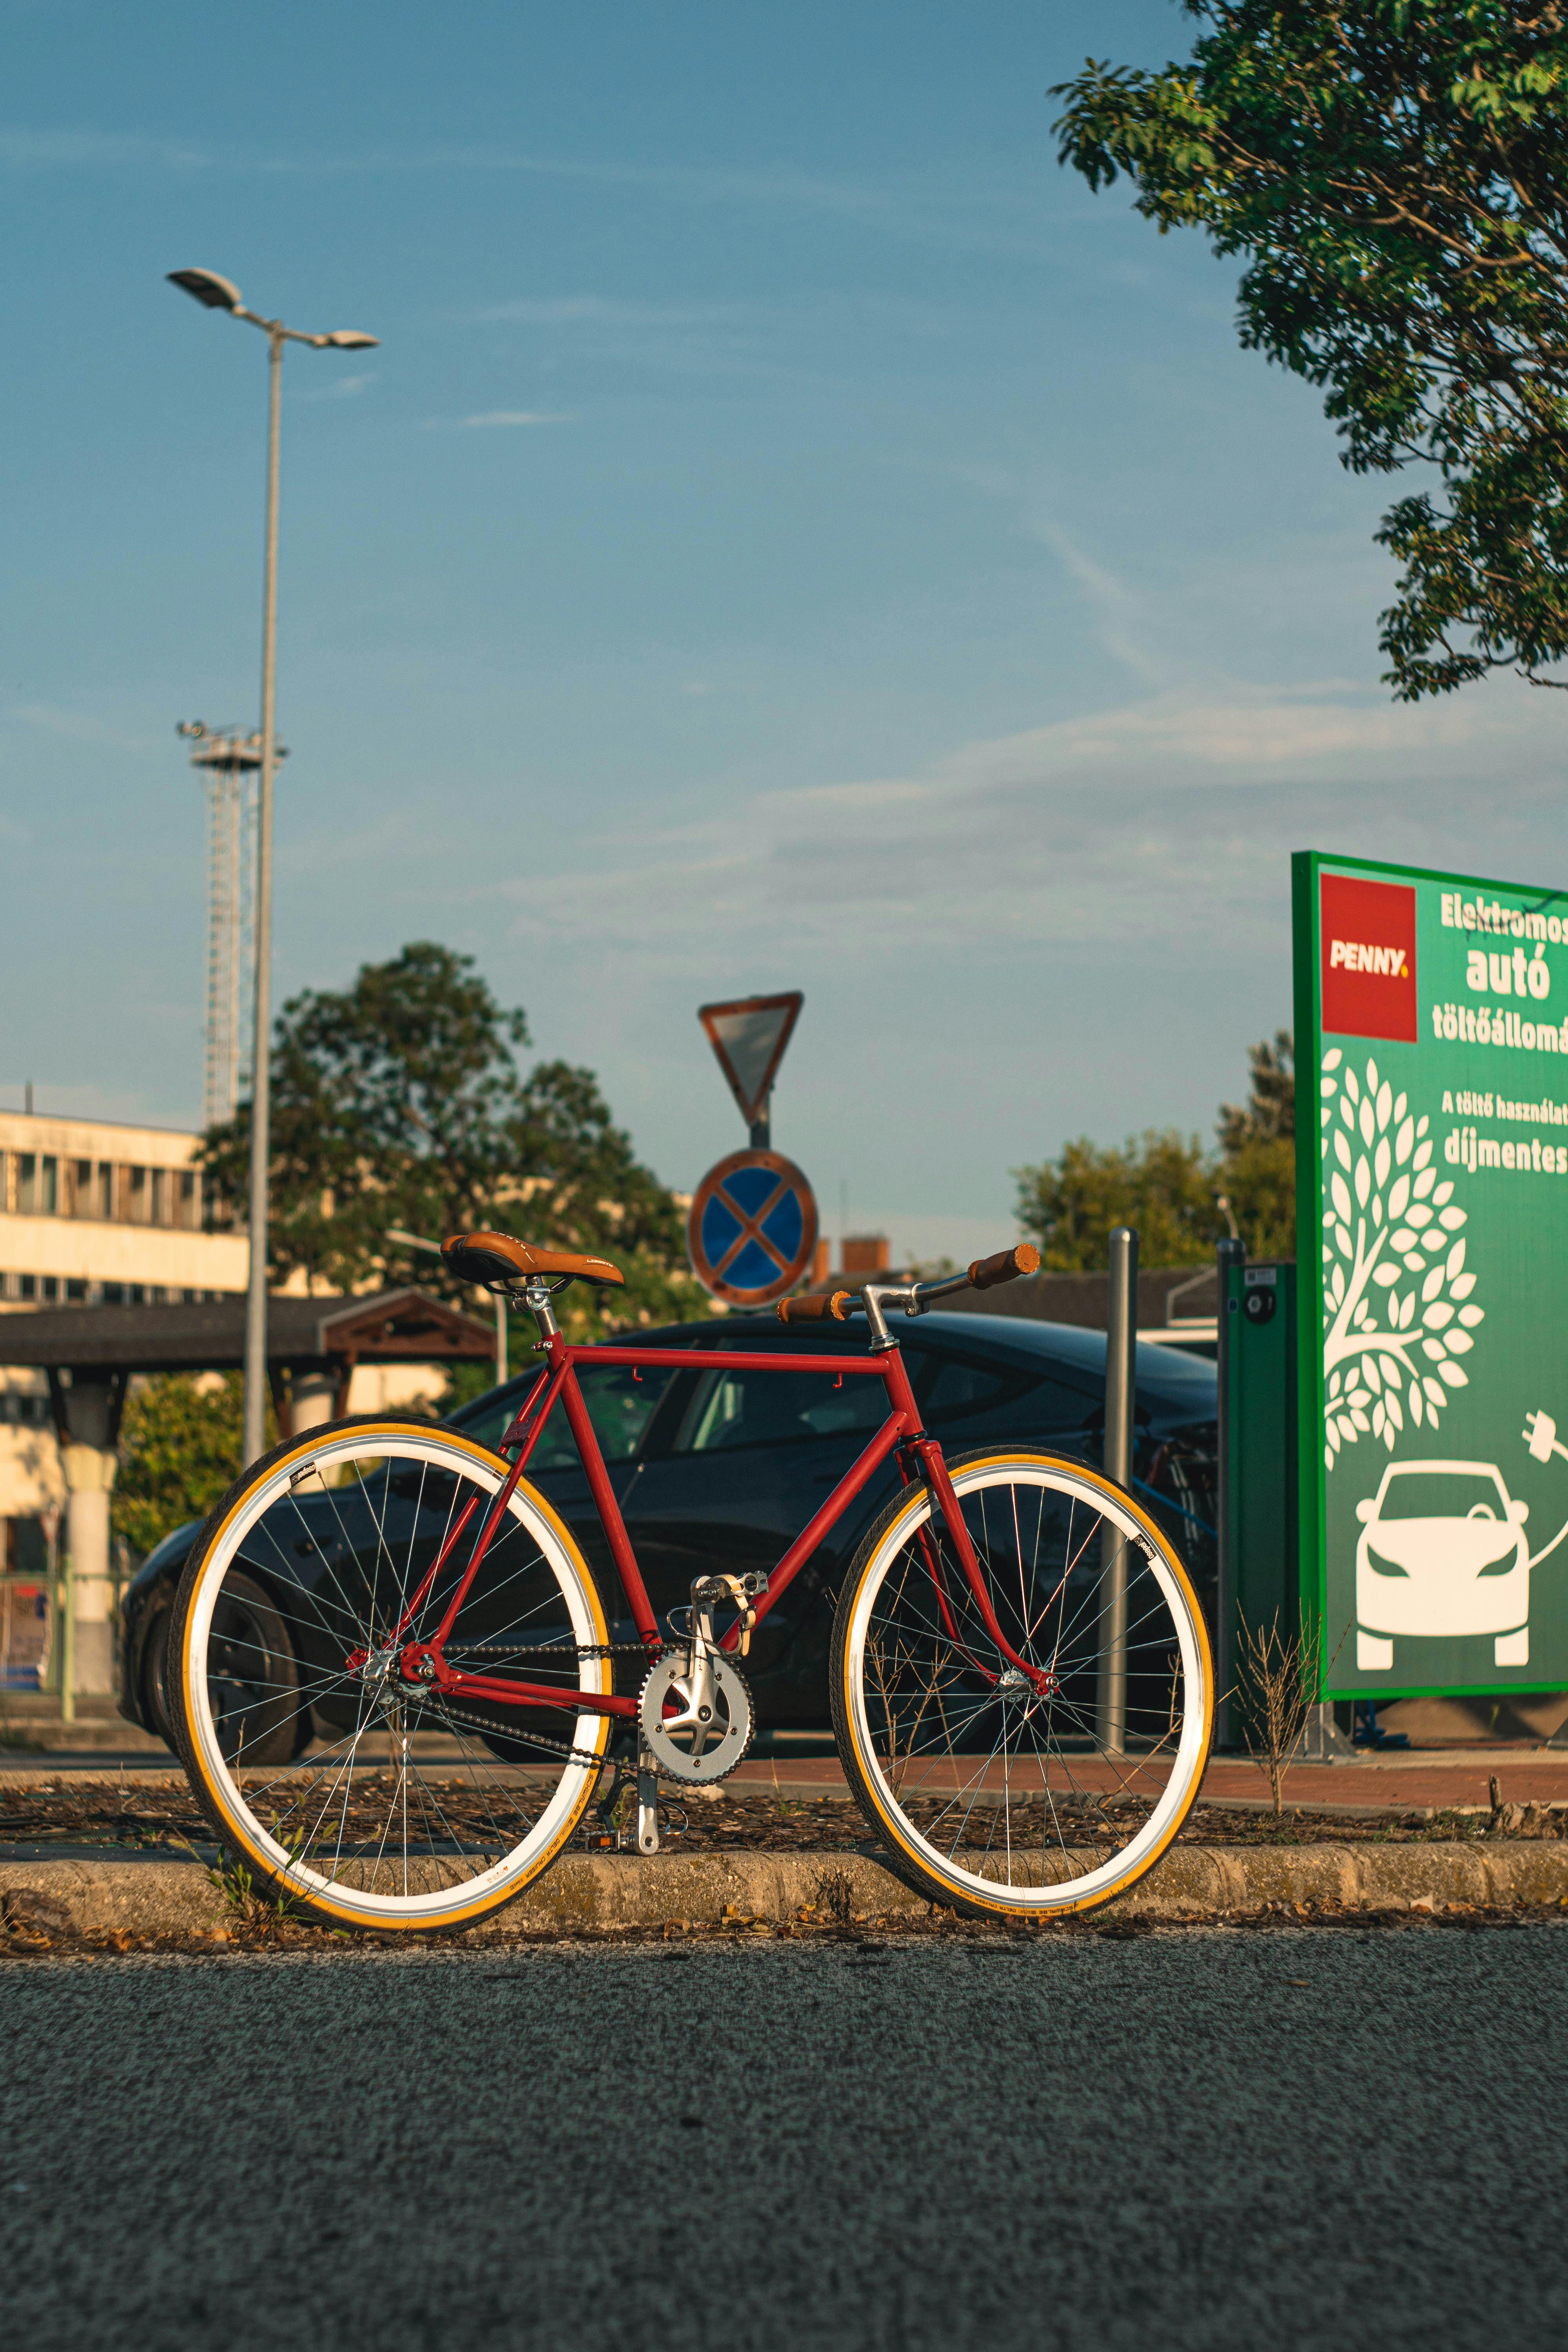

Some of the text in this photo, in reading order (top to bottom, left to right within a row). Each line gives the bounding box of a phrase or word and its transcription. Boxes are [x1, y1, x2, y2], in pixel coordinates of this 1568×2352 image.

[1466, 942, 1550, 1000] autó
[1442, 1091, 1454, 1113] A
[1444, 1126, 1568, 1174] díjmentes
[587, 1259, 613, 1267] LIBERTY
[573, 1773, 593, 1816] SCHWALBE
[546, 1838, 560, 1857] DELTA
[525, 1856, 546, 1878] CRUISER
[975, 1898, 997, 1908] CRUISER
[1039, 1906, 1073, 1915] SCHWALBE
